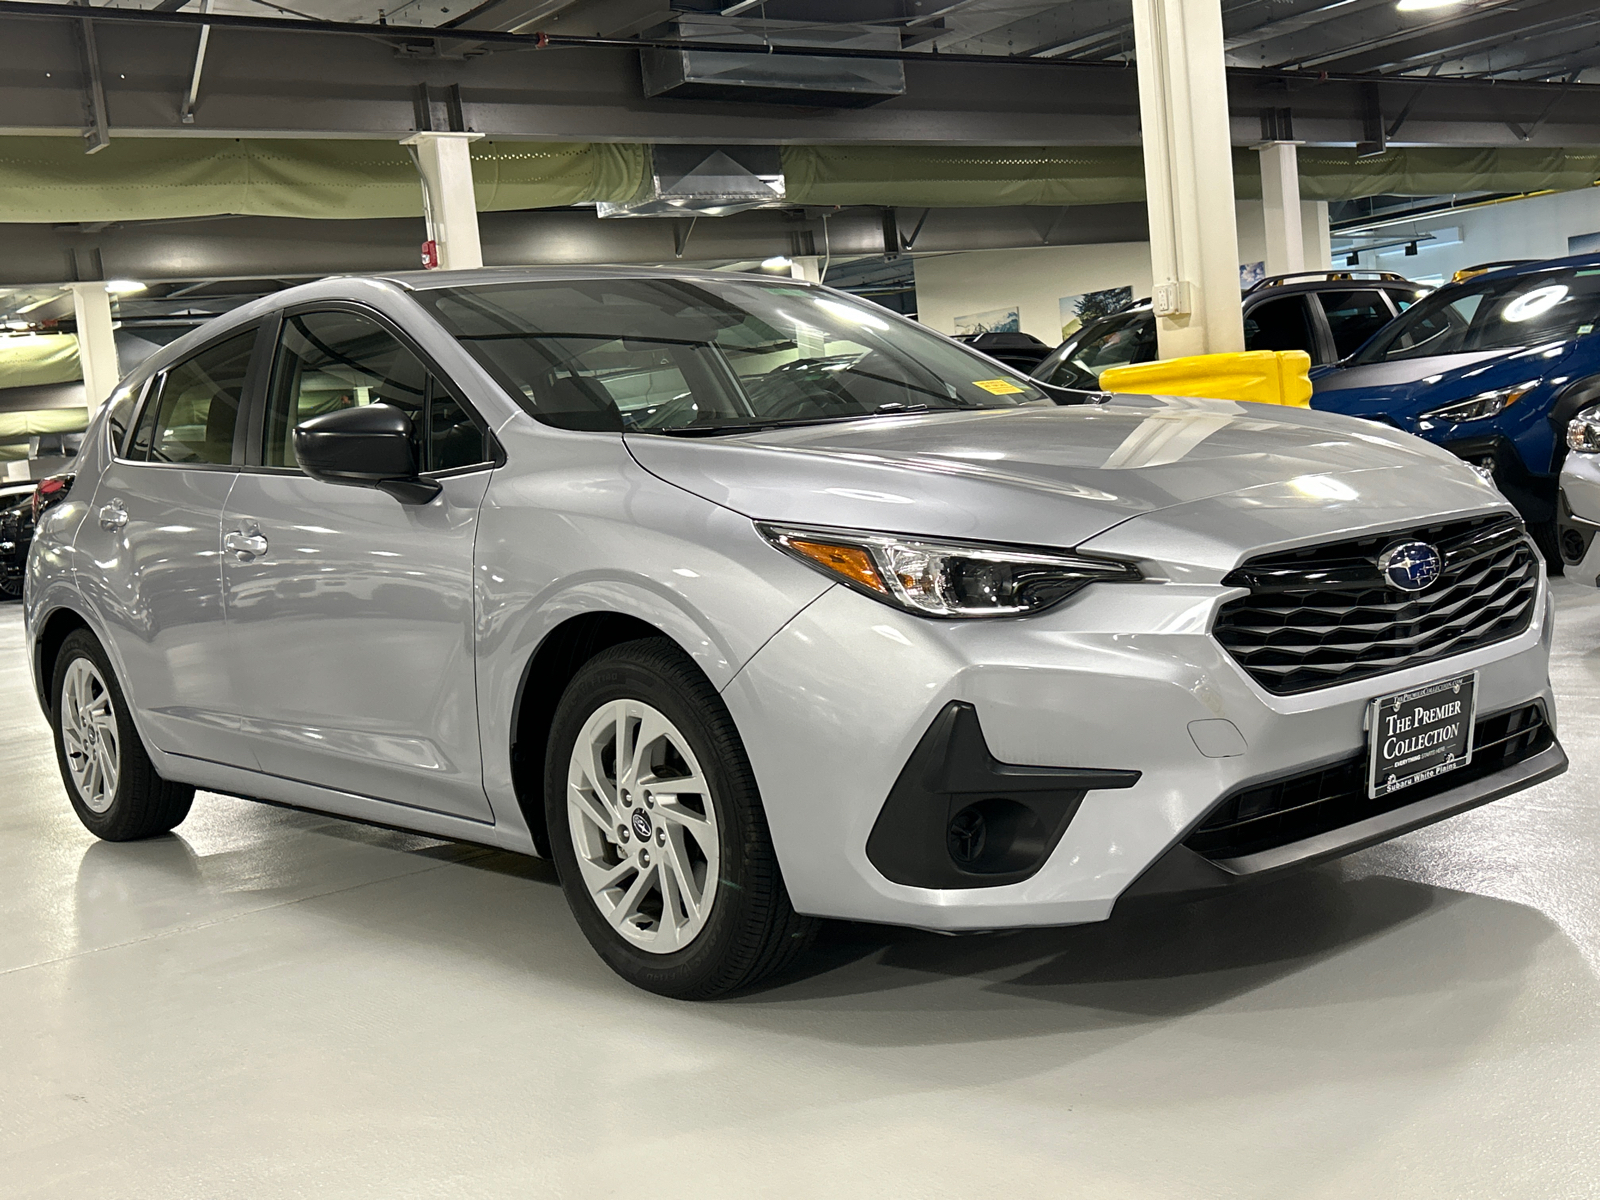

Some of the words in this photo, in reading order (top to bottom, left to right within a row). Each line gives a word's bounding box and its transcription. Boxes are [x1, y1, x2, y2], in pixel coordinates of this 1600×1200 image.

[1385, 713, 1412, 737] THE
[1413, 700, 1462, 728] PREMIER
[1383, 722, 1460, 760] COLLECTION
[1386, 778, 1412, 793] Subaru
[1413, 770, 1435, 783] White
[1435, 762, 1457, 776] Plains
[1394, 754, 1421, 768] EVERYTHING
